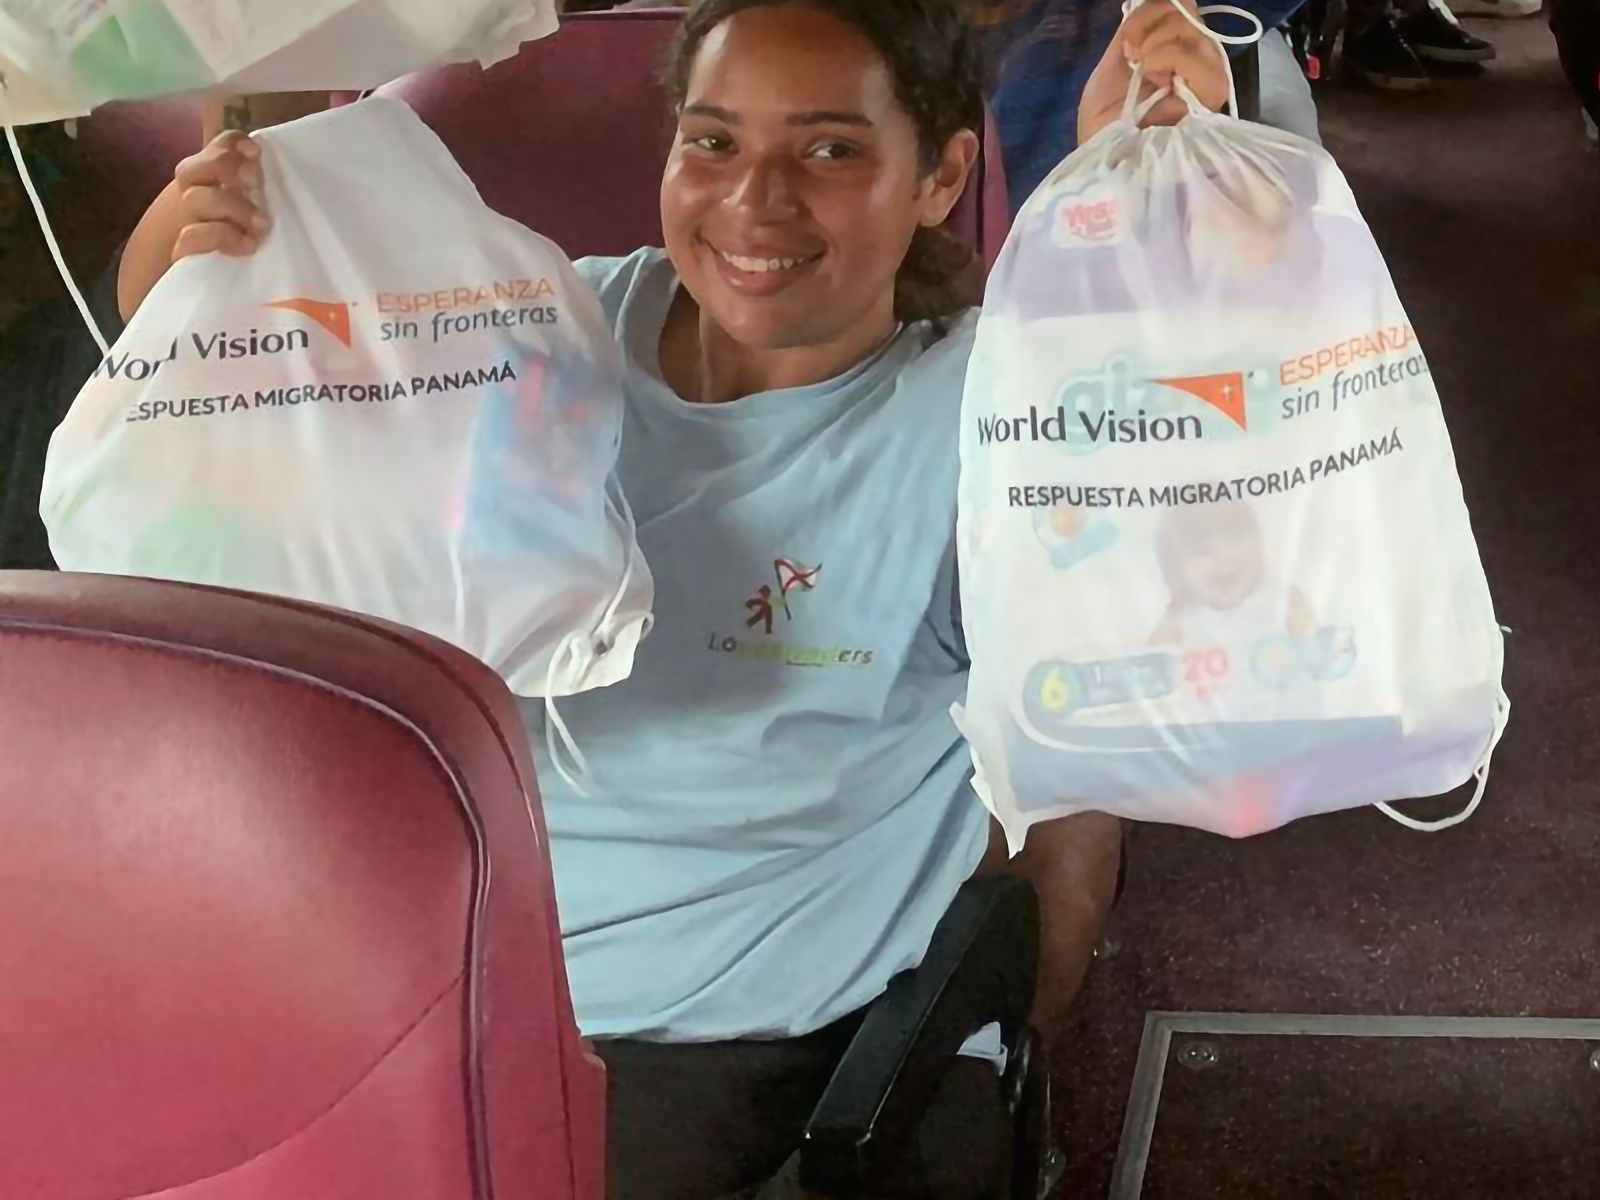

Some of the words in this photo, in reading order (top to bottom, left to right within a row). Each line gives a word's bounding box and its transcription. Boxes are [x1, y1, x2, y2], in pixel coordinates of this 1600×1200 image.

[377, 277, 555, 314] ESPERANZA
[379, 319, 419, 342] sin
[429, 304, 559, 343] fronteras
[191, 327, 309, 361] Vision
[1279, 322, 1418, 387] ESPERANZA
[254, 380, 407, 408] MIGRATORIA
[411, 360, 517, 396] PANAMÁ
[1281, 386, 1321, 420] sin
[977, 405, 1068, 445] World
[1077, 407, 1203, 444] Vision
[1008, 484, 1144, 508] RESPUESTA
[1149, 465, 1306, 507] MIGRATORIA
[1308, 426, 1405, 481] PANAMÁ
